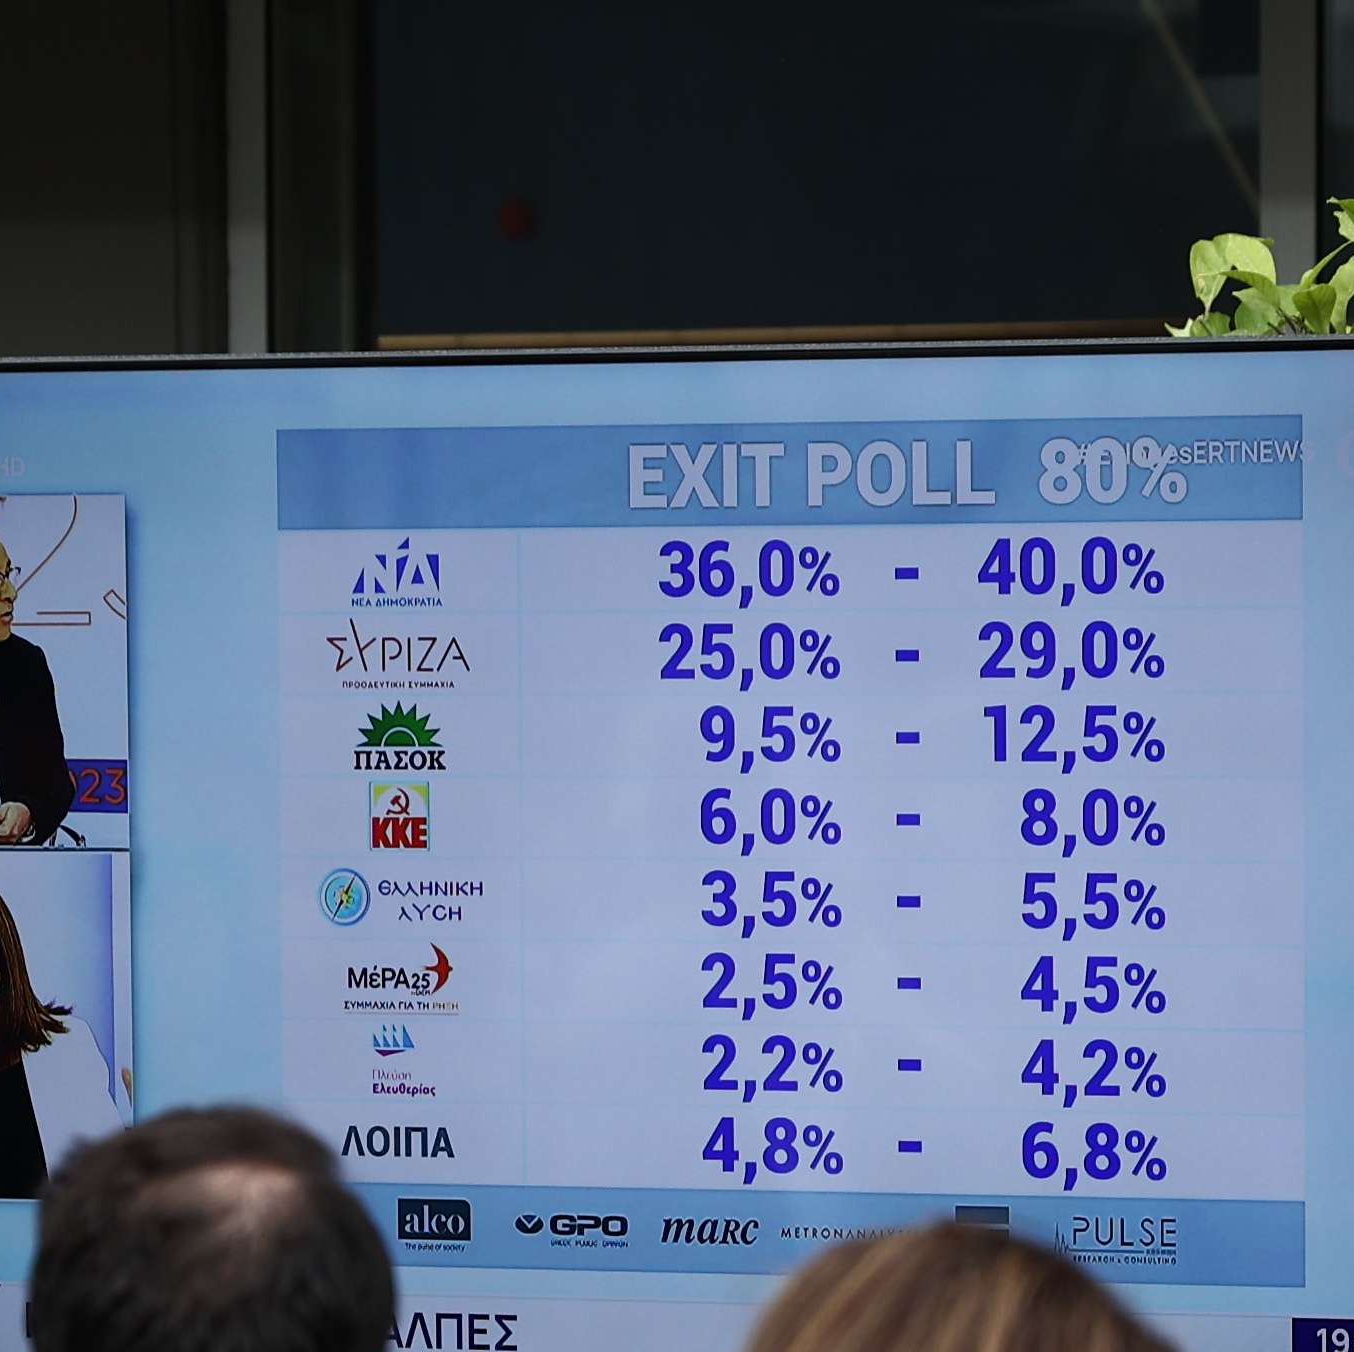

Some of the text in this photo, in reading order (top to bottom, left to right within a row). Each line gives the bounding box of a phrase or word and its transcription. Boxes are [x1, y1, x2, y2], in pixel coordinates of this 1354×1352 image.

[628, 436, 1188, 509] EXIT POLL 80%
[352, 597, 443, 607] ΝΕΑ ΔΗΜΟΚΡΑΤΙΑ
[659, 539, 841, 609] 36,0%
[978, 536, 1165, 607] 40,0%
[660, 622, 841, 692] 25,0%
[978, 620, 1165, 690] 29,0%
[354, 749, 446, 771] ΠΑΣΟΚ
[700, 705, 842, 774] 9,5%
[984, 704, 1166, 774] 12,5%
[371, 817, 428, 849] ΚΚΕ
[701, 787, 842, 857] 6,0%
[1021, 788, 1166, 858] 8,0%
[701, 870, 843, 939] 3,5%
[1021, 872, 1167, 941] 5,5%
[702, 952, 843, 1021] 2,5%
[1021, 955, 1167, 1025] 4,5%
[373, 1083, 436, 1097] Ελευθερίας
[702, 1034, 844, 1103] 2,2%
[1021, 1039, 1167, 1109] 4,2%
[341, 1125, 455, 1158] ΛΟΙΠΑ
[702, 1116, 844, 1185] 4,8%
[1021, 1121, 1168, 1191] 6,8%
[405, 1205, 465, 1234] alco
[550, 1215, 628, 1237] GPO
[1073, 1216, 1177, 1247] PULSE
